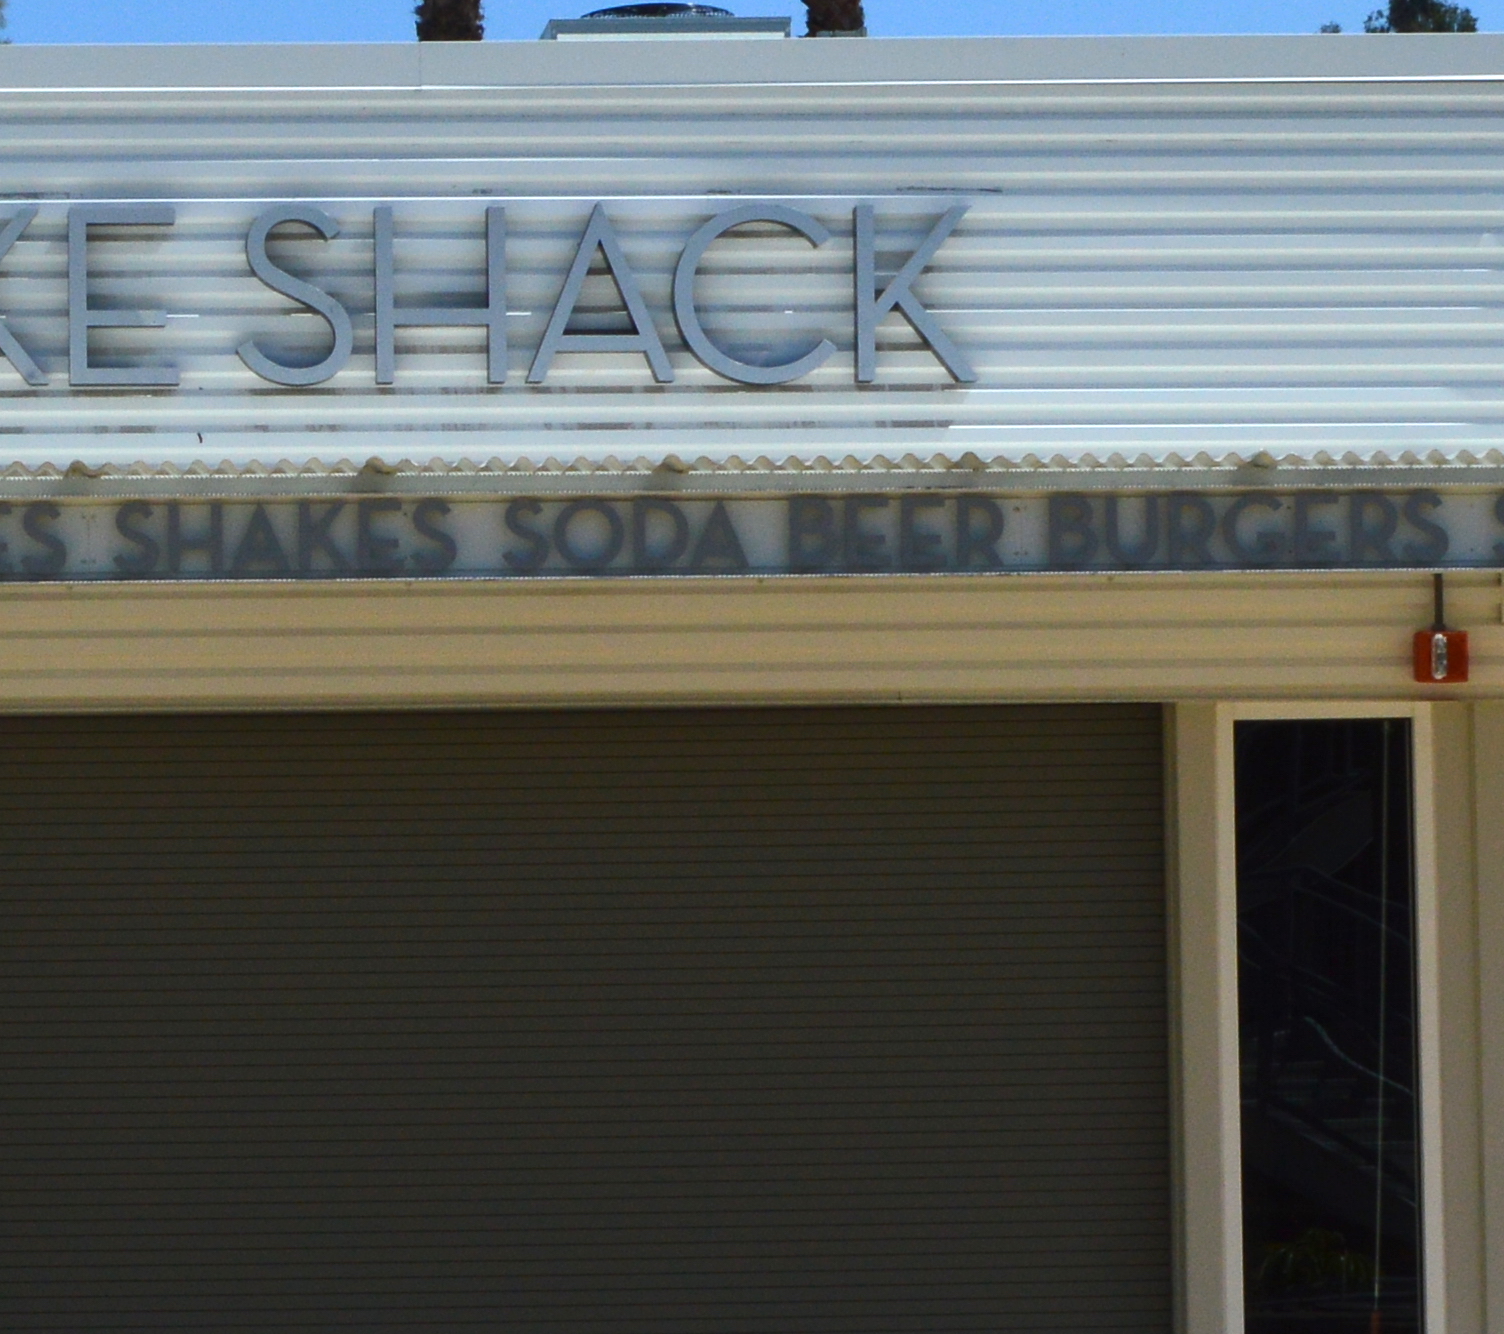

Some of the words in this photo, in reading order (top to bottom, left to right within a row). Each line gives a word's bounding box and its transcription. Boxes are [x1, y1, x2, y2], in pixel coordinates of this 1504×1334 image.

[236, 200, 977, 387] SHACK
[113, 496, 458, 574] SHAKES
[502, 495, 750, 571] SODA
[788, 492, 1005, 569] BEER
[1048, 488, 1450, 567] BURGERS
